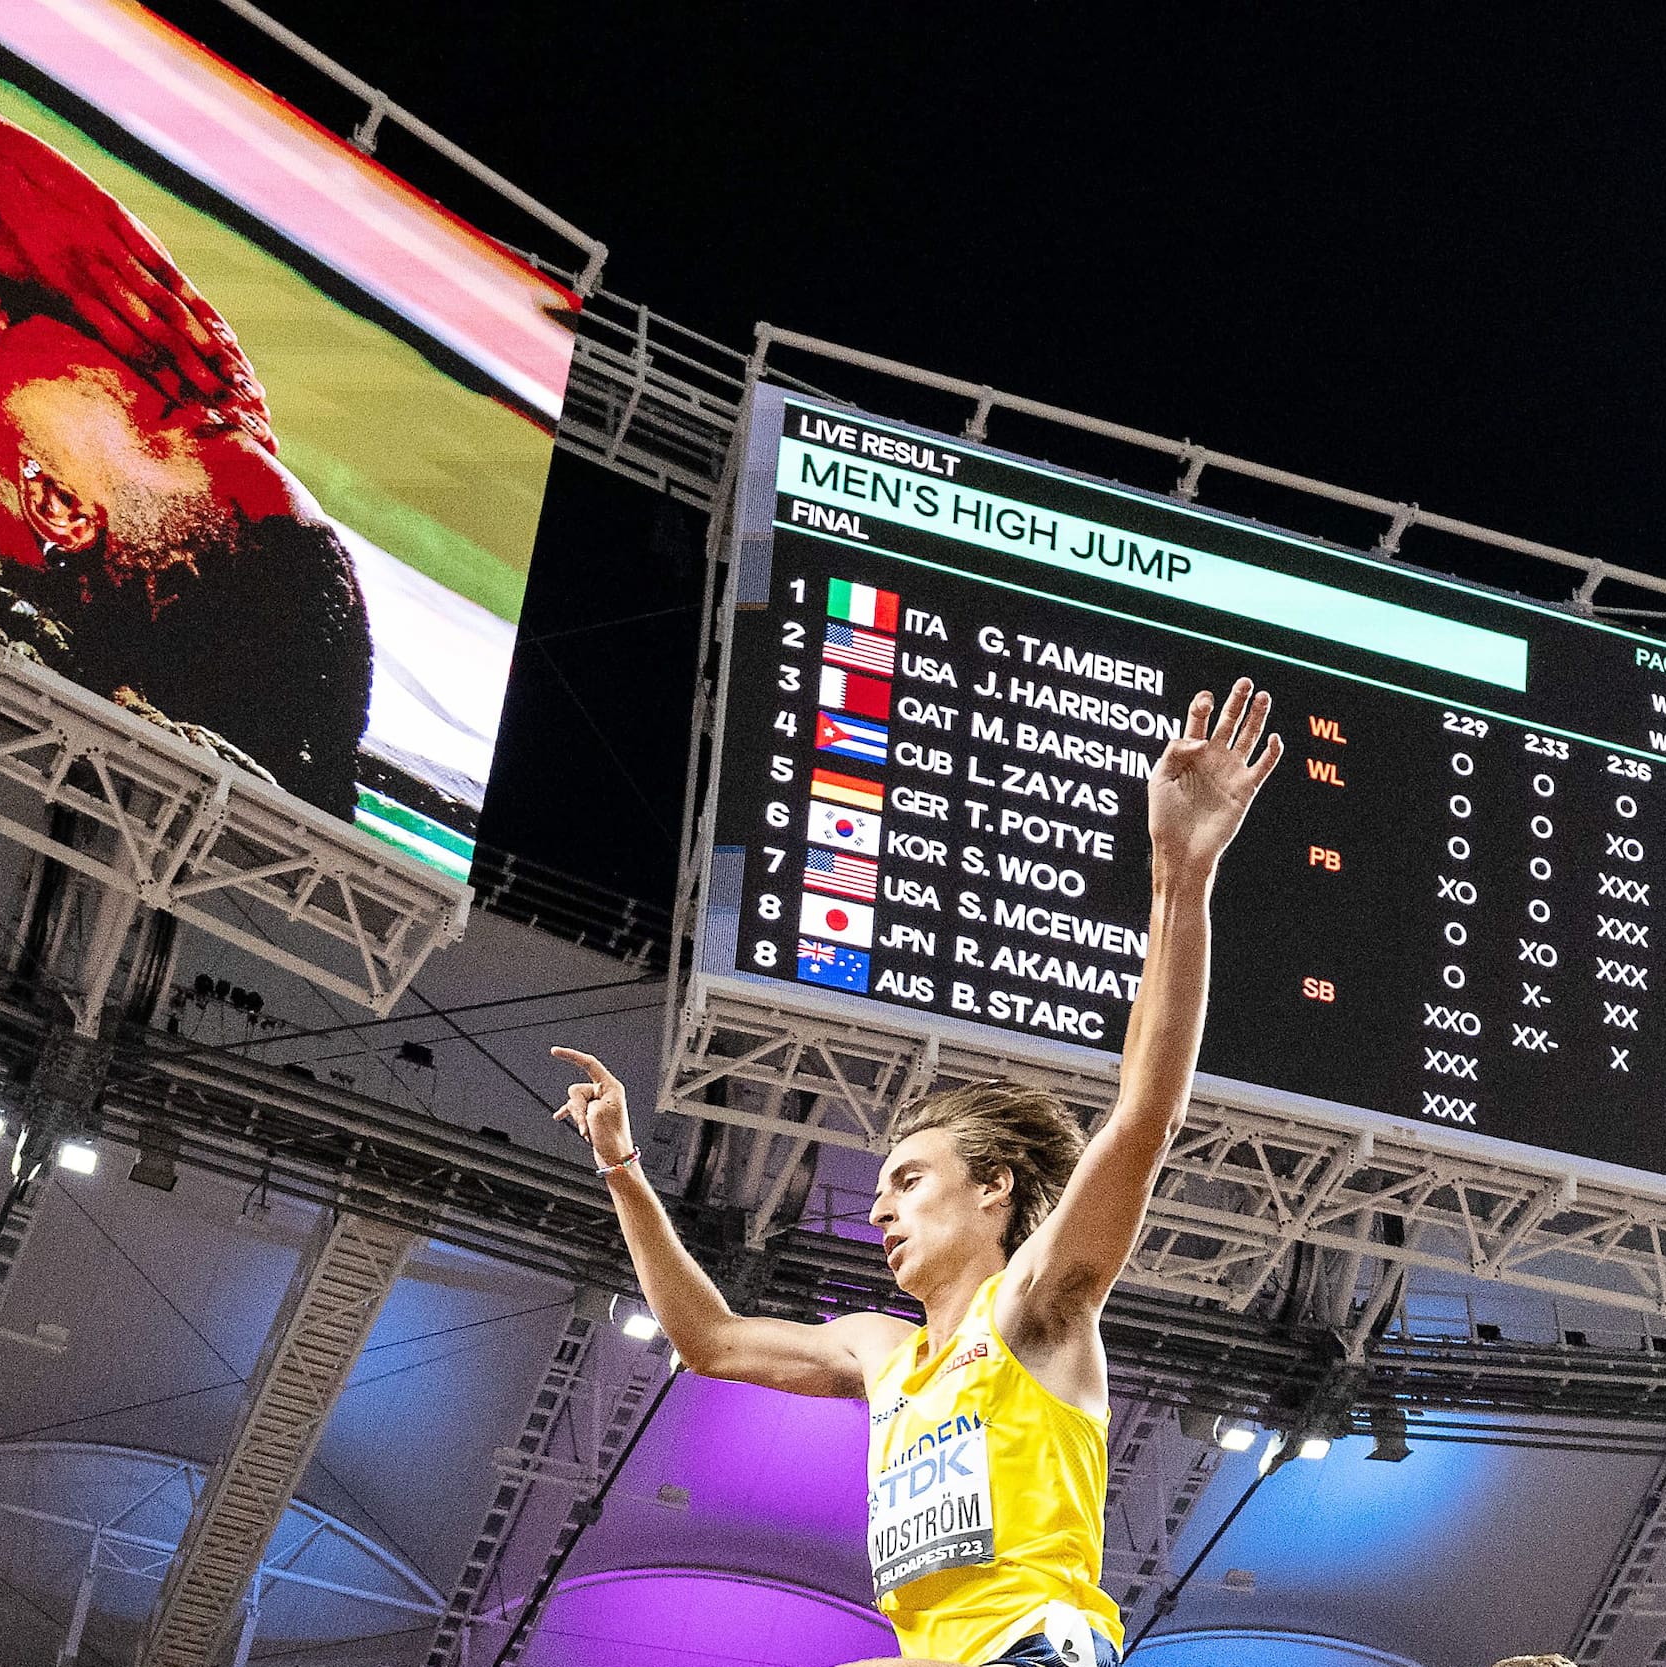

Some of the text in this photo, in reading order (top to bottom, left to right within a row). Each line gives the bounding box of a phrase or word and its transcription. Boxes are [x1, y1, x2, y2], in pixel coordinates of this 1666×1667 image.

[791, 499, 870, 541] FINAL
[800, 415, 961, 477] LIVE RESULT
[800, 452, 1192, 583] MEN'S HIGH JUMP
[782, 622, 805, 649] 2
[901, 652, 958, 688] USA
[973, 672, 1002, 700] J.
[1010, 677, 1181, 741] HARRISON
[1307, 758, 1345, 787] WL
[1606, 833, 1643, 862] XO
[789, 578, 805, 604] 1
[904, 608, 949, 641] ITA
[978, 625, 1010, 658] G.
[1016, 635, 1164, 696] TAMBERI
[1308, 715, 1347, 745] WL
[770, 756, 794, 782] 5
[891, 786, 949, 821] GER
[964, 800, 994, 832] T.
[1000, 810, 1114, 861] POTYE
[1518, 938, 1558, 967] XO
[1596, 956, 1648, 990] XXX
[774, 710, 797, 738] 4
[894, 742, 953, 776] CUB
[967, 756, 995, 787] L.
[1002, 765, 1120, 817] ZAYAS
[1309, 845, 1341, 871] PB
[1438, 875, 1477, 904] XO
[1597, 914, 1649, 948] XXX
[778, 664, 801, 691] 3
[897, 695, 958, 732] QAT
[971, 711, 1010, 746] M.
[1598, 872, 1650, 906] XXX
[758, 894, 782, 920] 8
[879, 924, 935, 956] JPN
[954, 936, 984, 968] R.
[1424, 1047, 1478, 1081] XXX
[763, 847, 786, 873] 7
[884, 876, 941, 912] USA
[958, 892, 986, 923] S.
[994, 898, 1148, 960] MCEWEN
[1302, 977, 1335, 1002] SB
[1424, 1003, 1481, 1036] XXO
[1610, 1046, 1630, 1072] X
[766, 802, 790, 828] 6
[887, 831, 948, 866] KOR
[961, 847, 990, 878] S.
[998, 854, 1086, 897] WOO
[1603, 1001, 1638, 1031] XX
[753, 941, 1476, 1125] 8 AUS B. STARC XXX
[875, 1492, 981, 1563] NDSTRÖM
[879, 1440, 974, 1508] TDK
[879, 1540, 984, 1586] BUDAPEST 23
